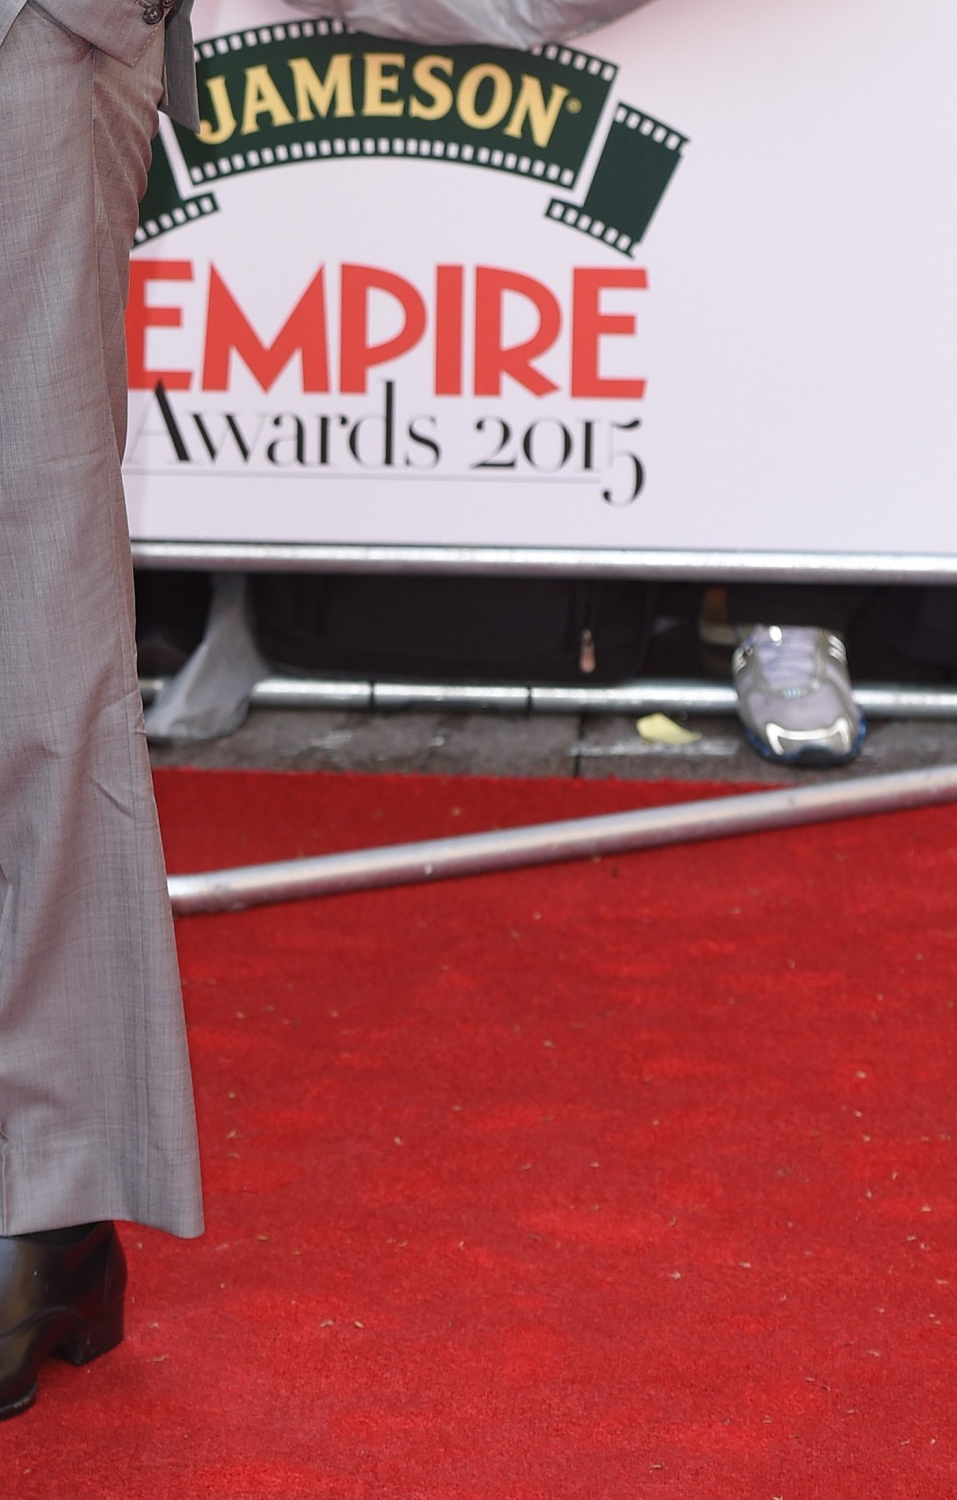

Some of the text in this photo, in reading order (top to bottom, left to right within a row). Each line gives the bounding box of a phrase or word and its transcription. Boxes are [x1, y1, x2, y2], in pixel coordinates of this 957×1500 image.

[196, 53, 570, 147] JAMESON
[125, 260, 649, 400] EMPIRE
[126, 377, 646, 507] Awards 2015
